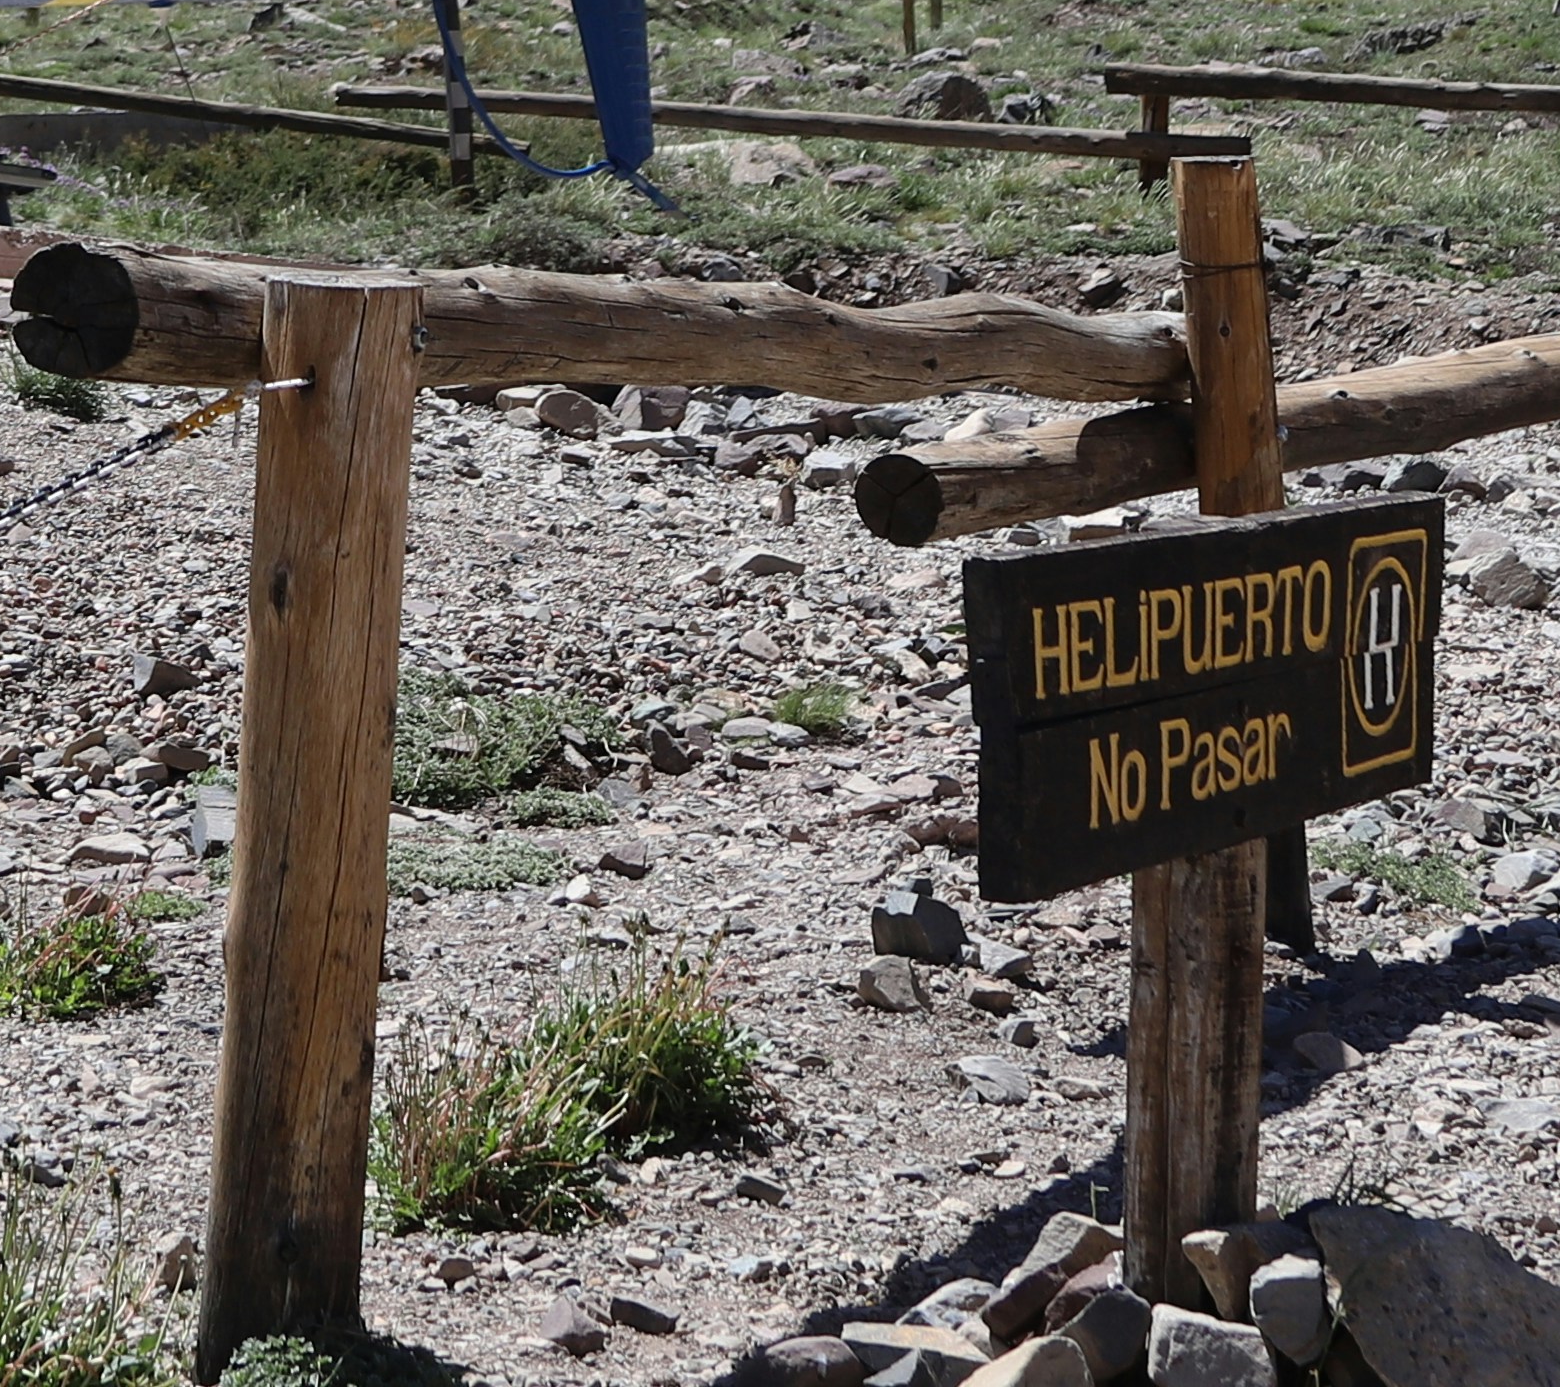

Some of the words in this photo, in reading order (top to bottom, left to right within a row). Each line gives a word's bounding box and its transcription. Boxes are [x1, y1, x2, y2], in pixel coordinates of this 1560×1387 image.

[1364, 583, 1402, 710] H
[1089, 732, 1147, 828] No
[1160, 712, 1292, 810] Pasar
